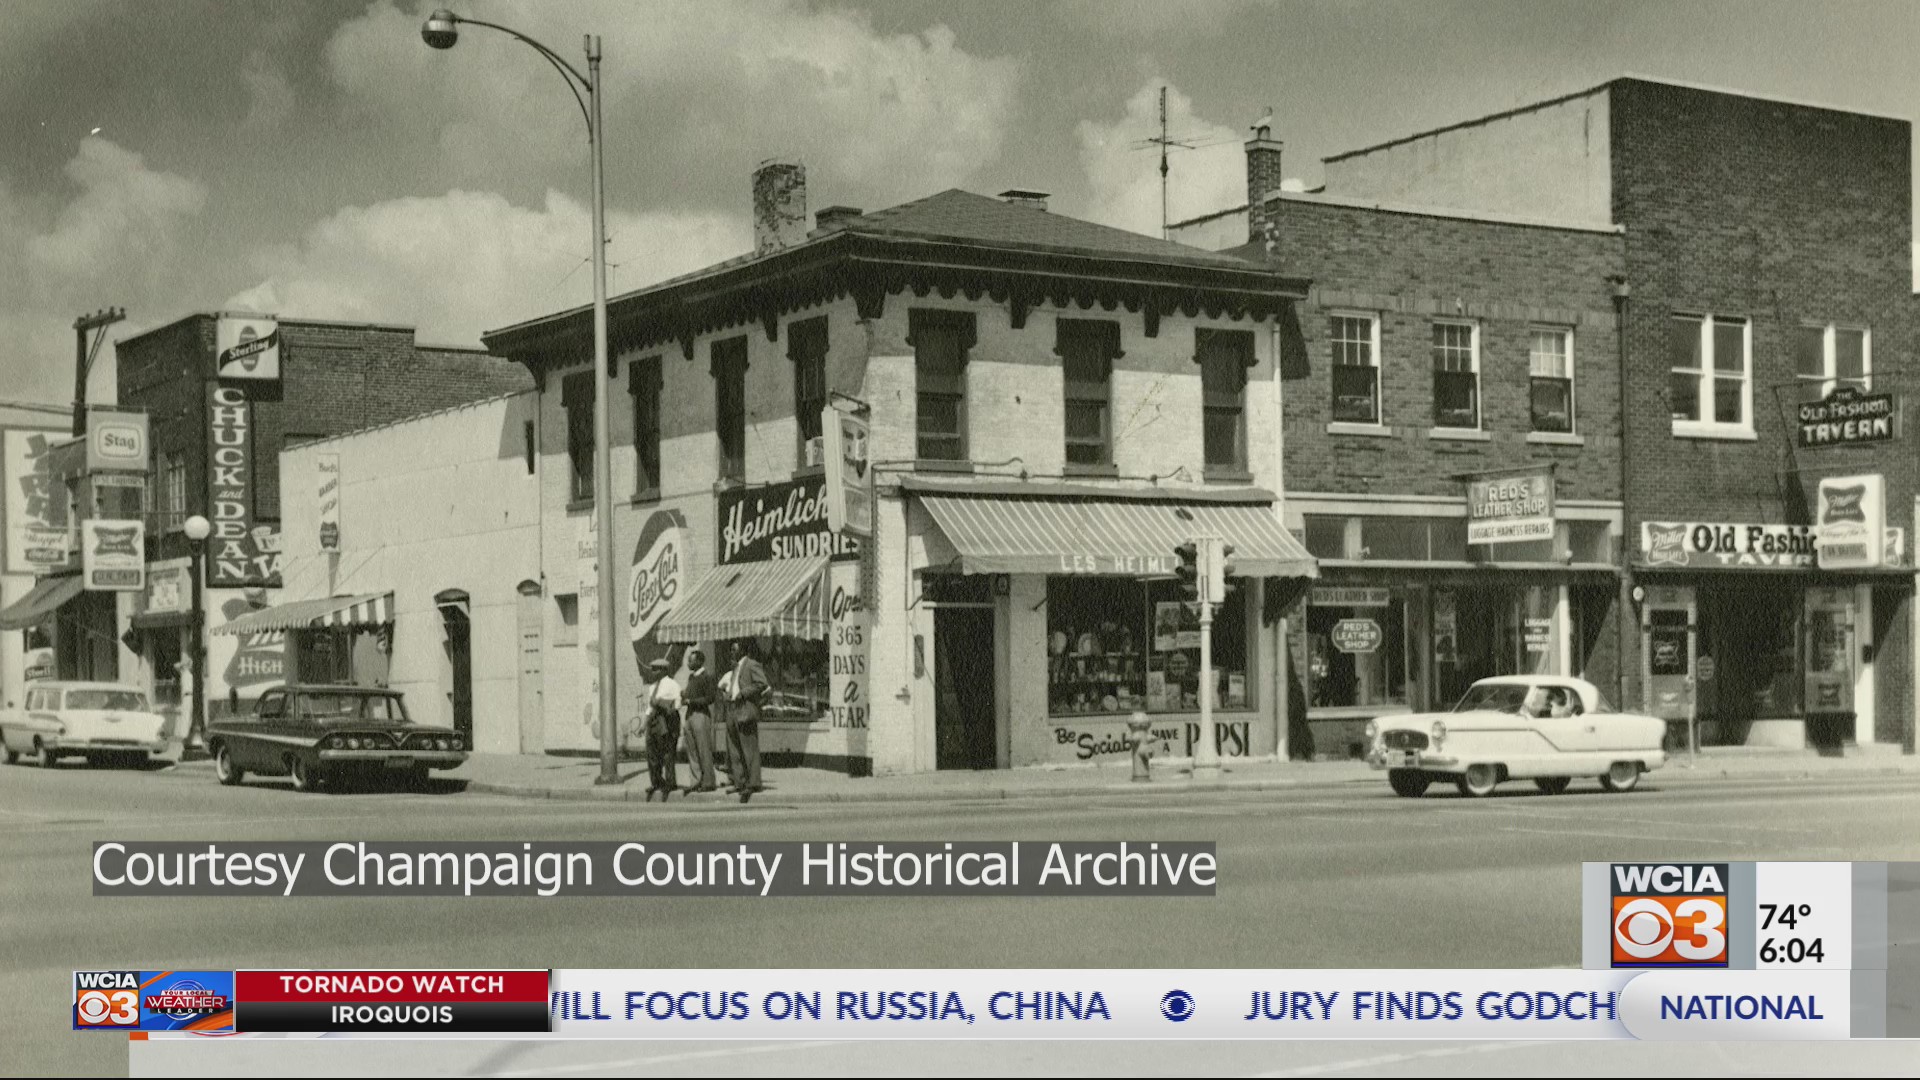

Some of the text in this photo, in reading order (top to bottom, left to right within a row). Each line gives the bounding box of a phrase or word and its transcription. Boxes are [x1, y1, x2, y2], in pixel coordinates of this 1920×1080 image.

[1800, 405, 1828, 420] OLD
[211, 387, 247, 486] CHUCK
[1803, 417, 1888, 443] TAVERN
[104, 433, 135, 449] Stag
[218, 488, 245, 499] and
[1473, 498, 1546, 518] LEATHER SHOP
[213, 501, 248, 579] DEAN
[1653, 532, 1684, 549] Miller
[1692, 525, 1736, 553] Old
[1061, 556, 1096, 572] LES
[1715, 554, 1813, 565] TAVER
[832, 585, 863, 622] Open
[836, 625, 862, 646] 365
[1336, 631, 1376, 640] LEATHER
[1344, 640, 1369, 649] SHOP
[834, 654, 865, 675] DAYS
[843, 680, 860, 703] a
[1054, 727, 1076, 744] Be
[1185, 721, 1250, 757] PPSI
